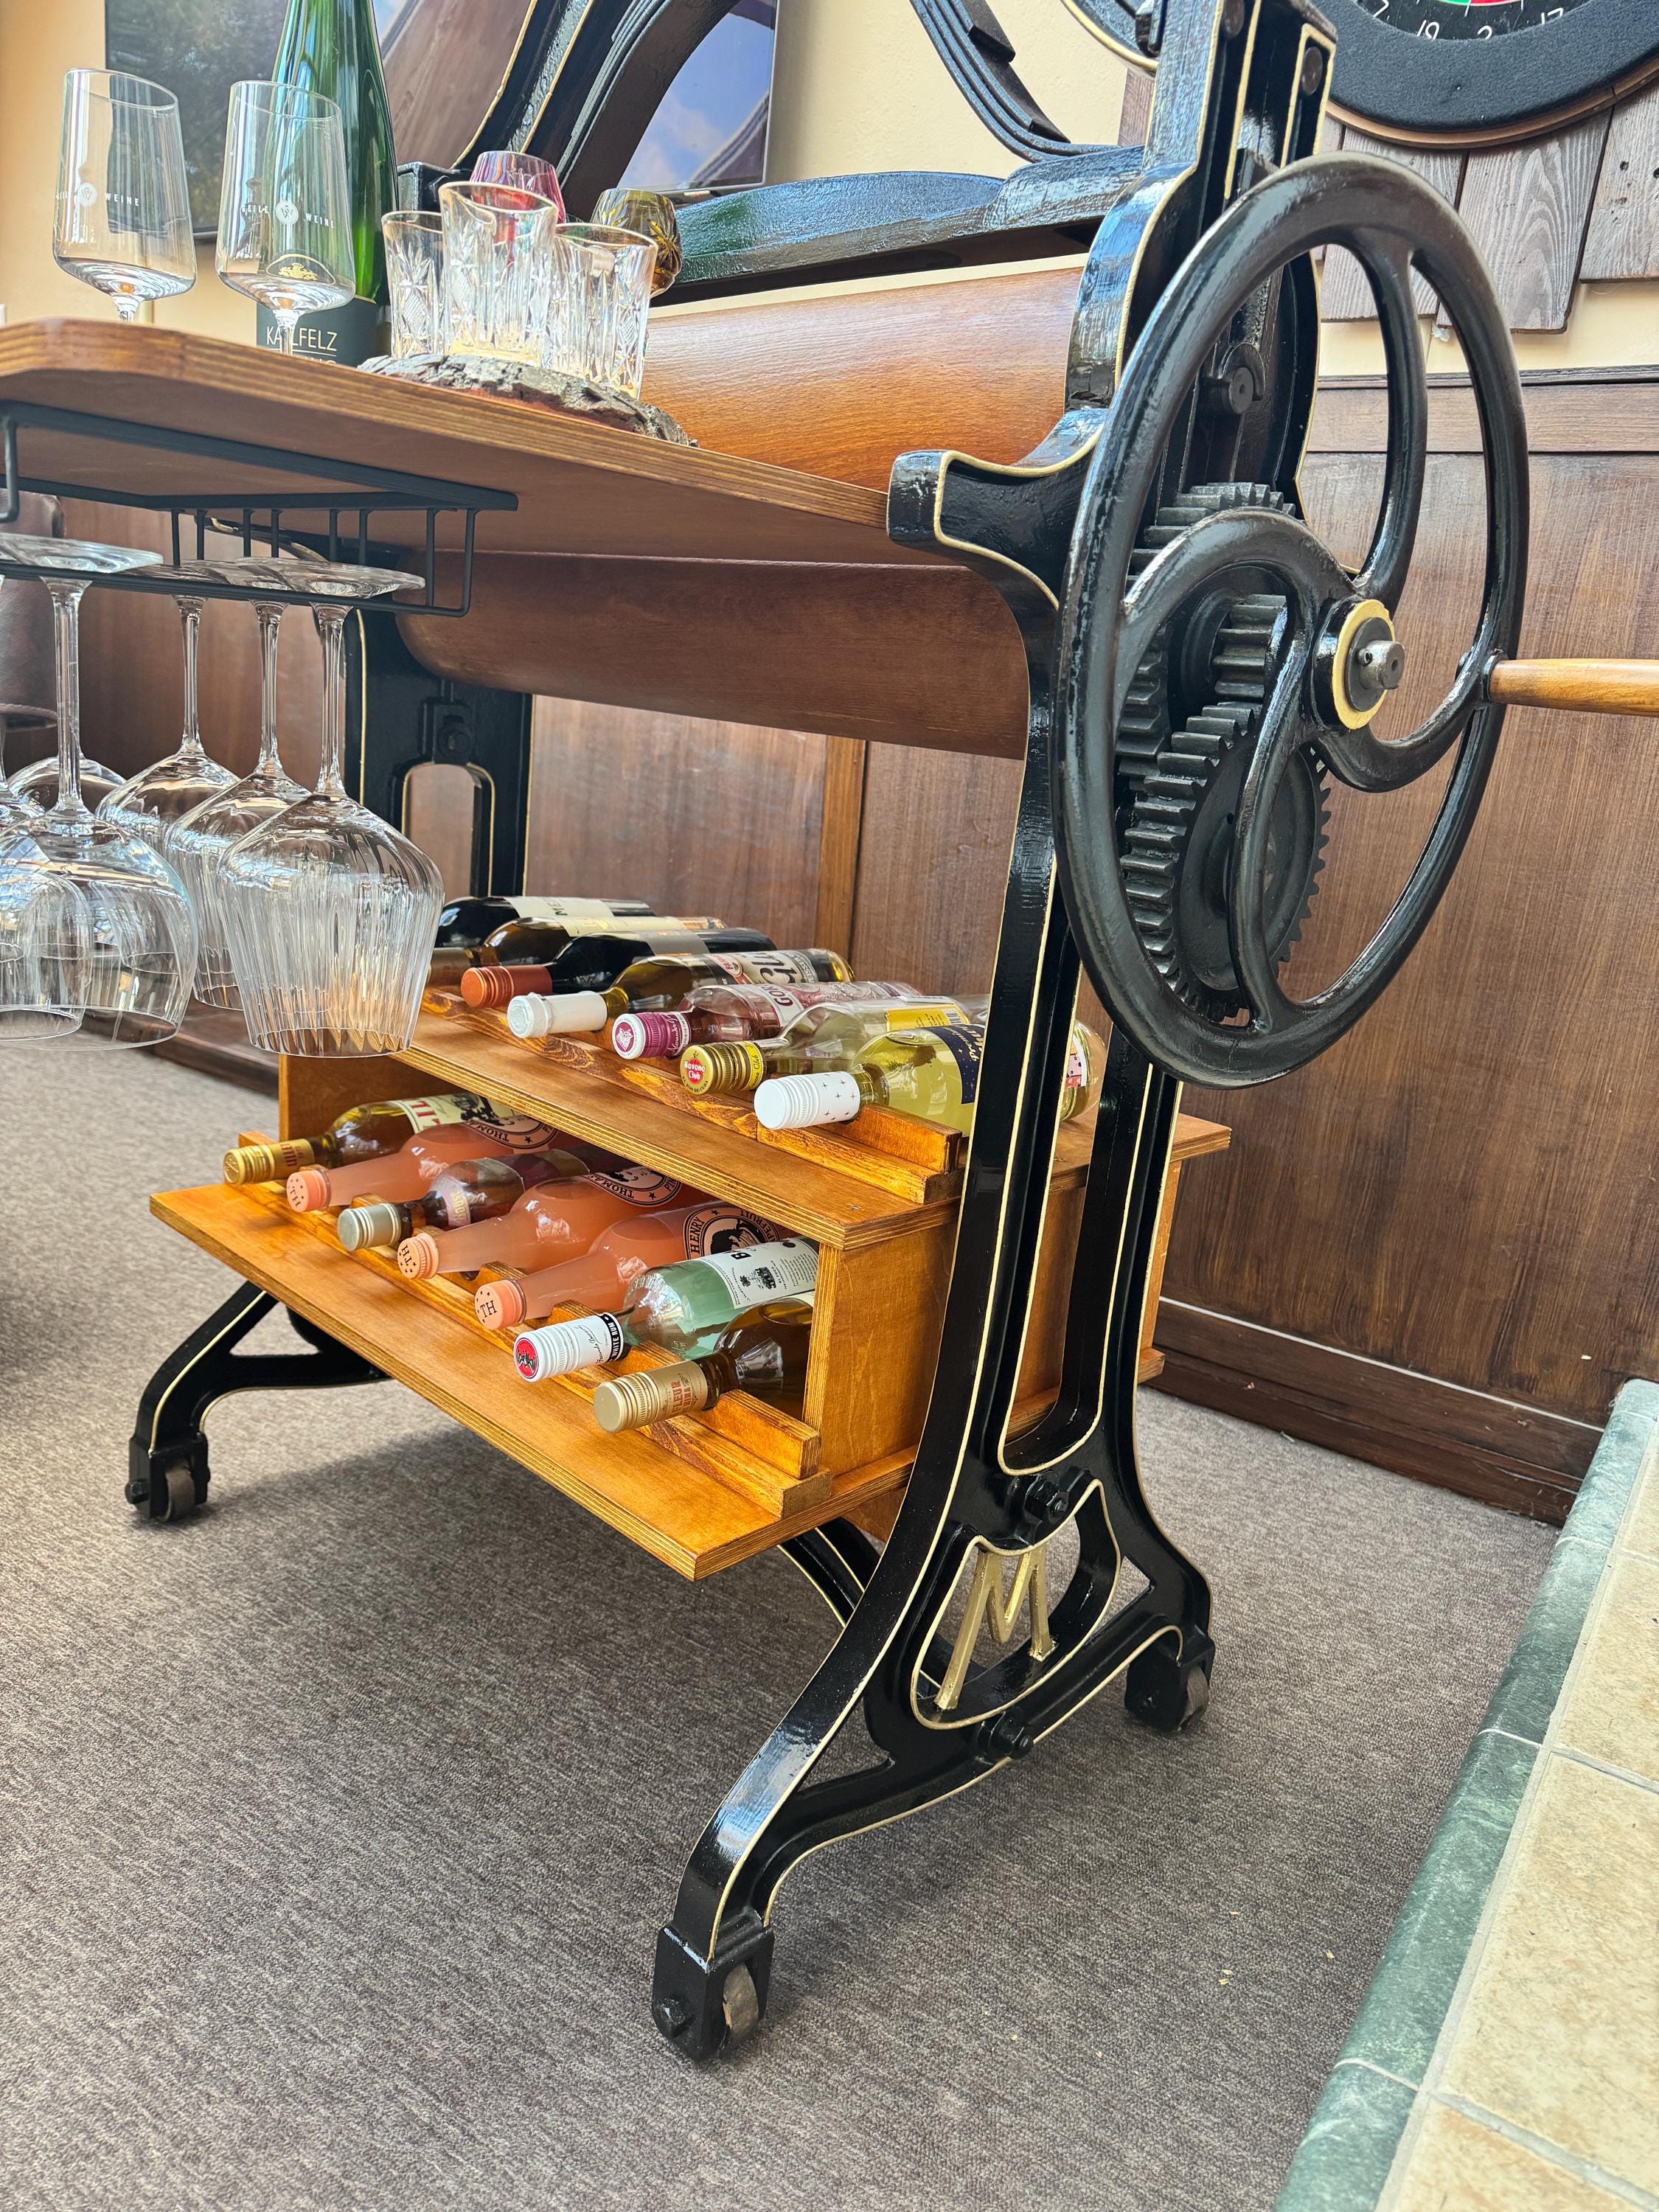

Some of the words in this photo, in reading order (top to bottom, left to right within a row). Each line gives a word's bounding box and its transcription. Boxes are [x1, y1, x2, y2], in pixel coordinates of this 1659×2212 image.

[105, 192, 140, 206] WEINE
[305, 212, 335, 229] WEINE
[684, 1060, 706, 1073] Havana
[688, 1070, 700, 1081] Club
[690, 1217, 706, 1255] HENRY
[401, 1244, 412, 1265] TH
[480, 1300, 498, 1318] TH
[608, 1322, 619, 1336] RUM
[611, 1336, 620, 1357] WHITE
